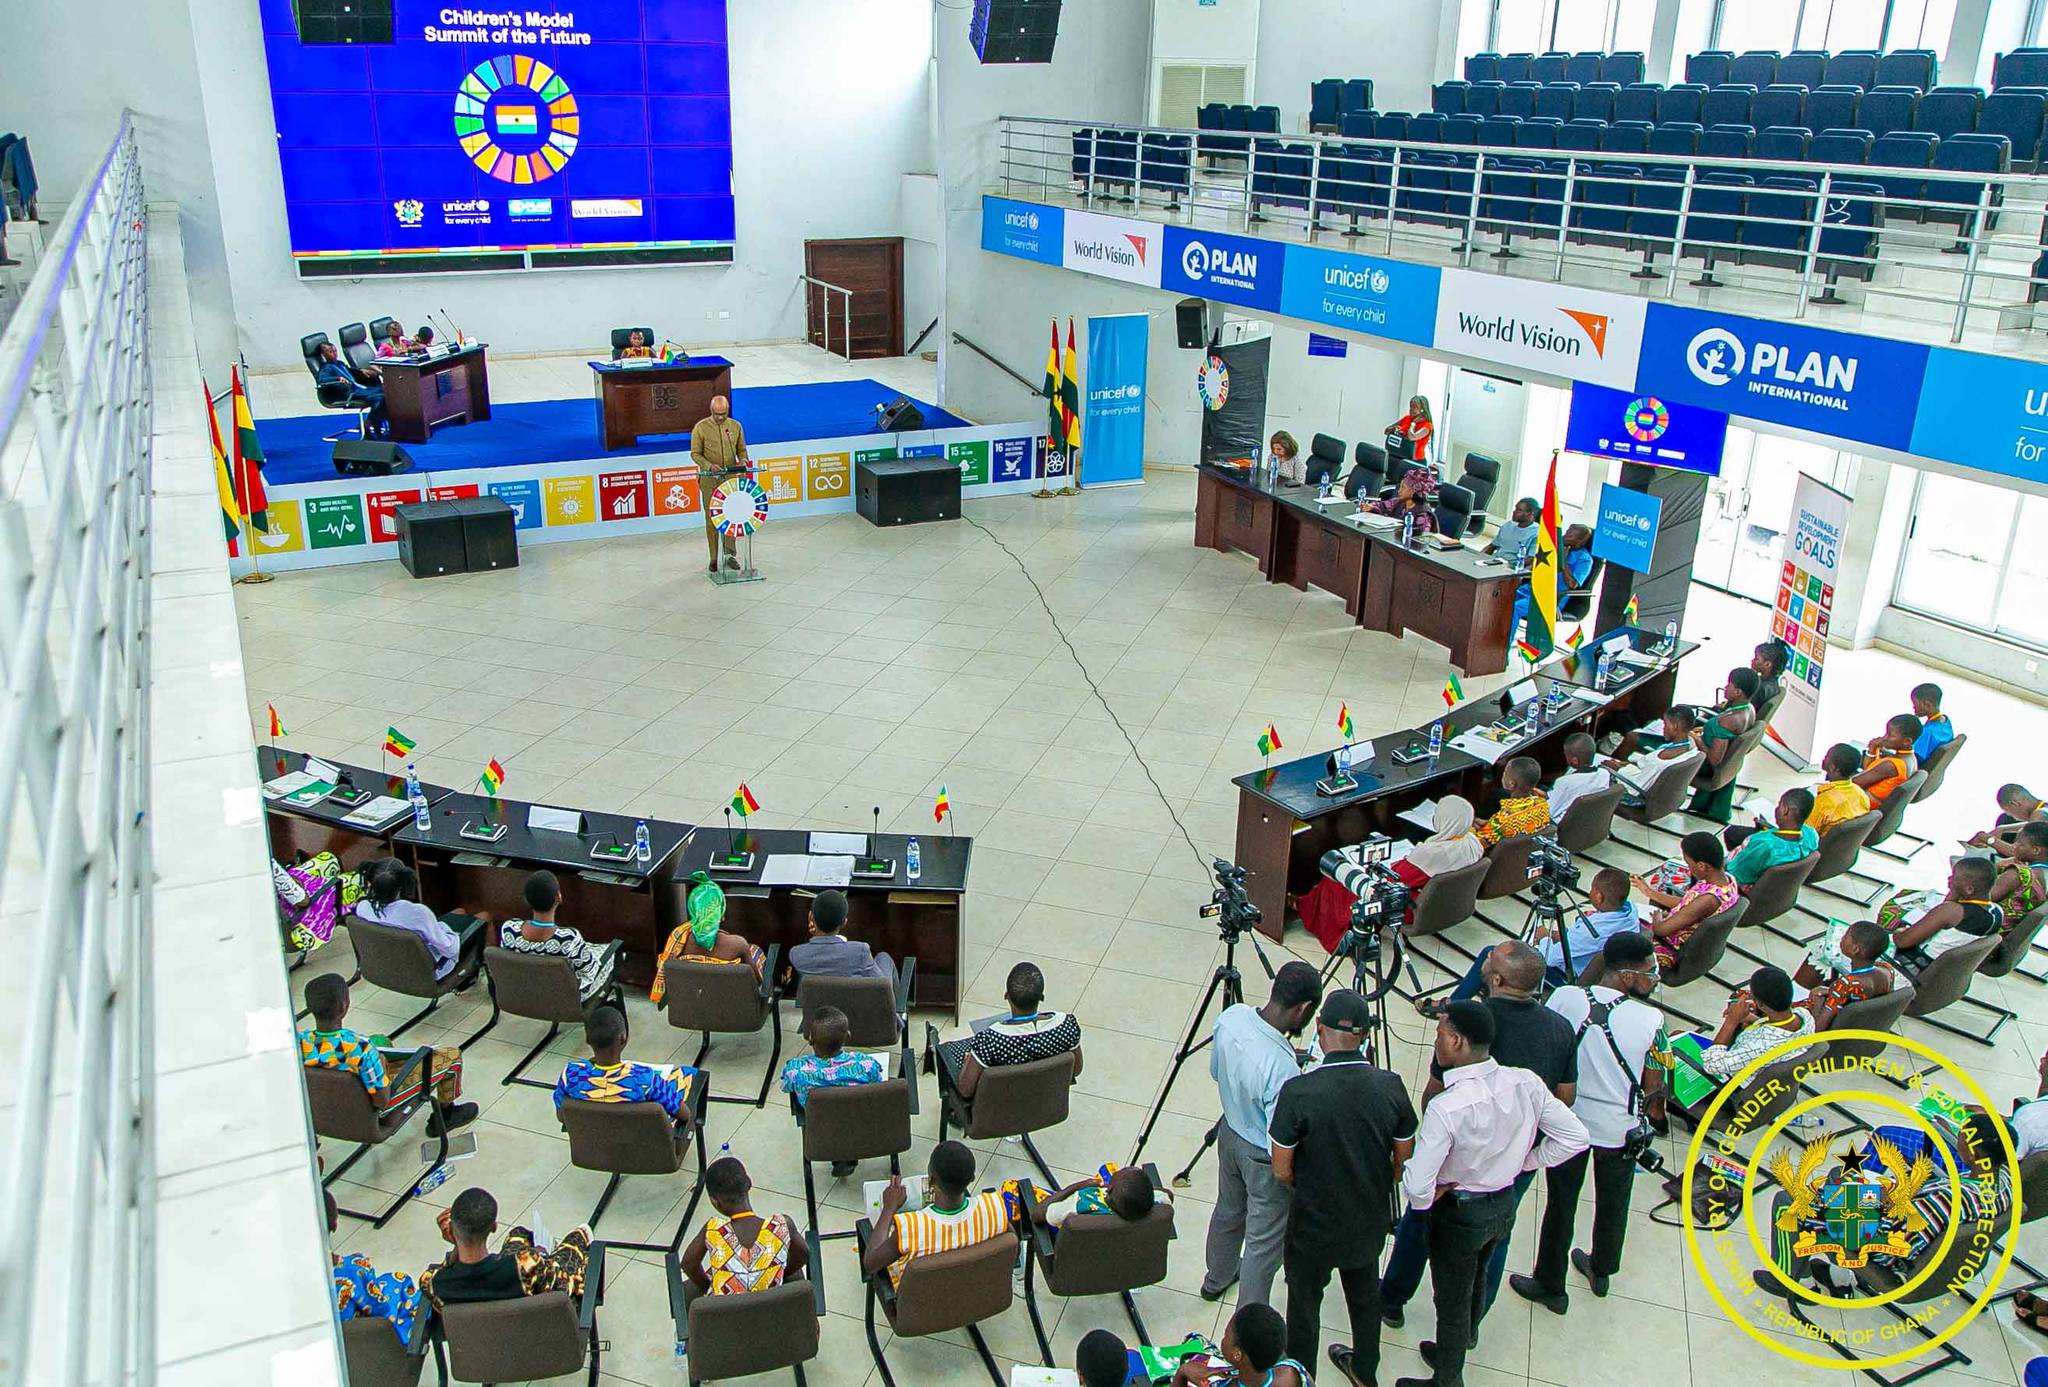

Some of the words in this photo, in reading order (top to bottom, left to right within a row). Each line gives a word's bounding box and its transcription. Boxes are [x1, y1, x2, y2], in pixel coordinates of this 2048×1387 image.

[440, 9, 522, 26] Children's
[525, 12, 574, 28] Model
[424, 26, 489, 43] Summit
[491, 28, 509, 43] of
[511, 29, 537, 44] the
[540, 29, 591, 45] Future
[443, 200, 476, 212] unicef
[1005, 210, 1028, 228] unicef
[1074, 240, 1103, 260] World
[1105, 246, 1134, 266] Vision
[1211, 249, 1257, 278] PLAN
[1210, 275, 1255, 290] INTERNATIONAL
[1325, 266, 1370, 290] unicef
[1322, 297, 1335, 313] for
[1336, 304, 1362, 322] every
[1363, 307, 1386, 324] child
[1459, 312, 1514, 342] World
[1520, 323, 1580, 356] Vision
[1751, 342, 1858, 392] PLAN
[1091, 385, 1126, 400] unicef
[1748, 381, 1849, 411] INTERNATIONAL
[1123, 405, 1140, 414] child
[950, 447, 959, 456] 15
[995, 443, 1003, 452] 16
[1038, 439, 1046, 448] 17
[2015, 436, 2046, 462] for
[809, 458, 818, 468] 12
[602, 477, 609, 488] 8
[655, 473, 662, 483] 9
[309, 502, 317, 513] 3
[371, 497, 378, 508] 4
[1605, 509, 1638, 527] unicef
[1800, 509, 1840, 537] SUSTAINABLE
[1612, 531, 1632, 543] every
[1798, 520, 1837, 547] DEVELOPMENT
[1795, 531, 1836, 568] GOALS
